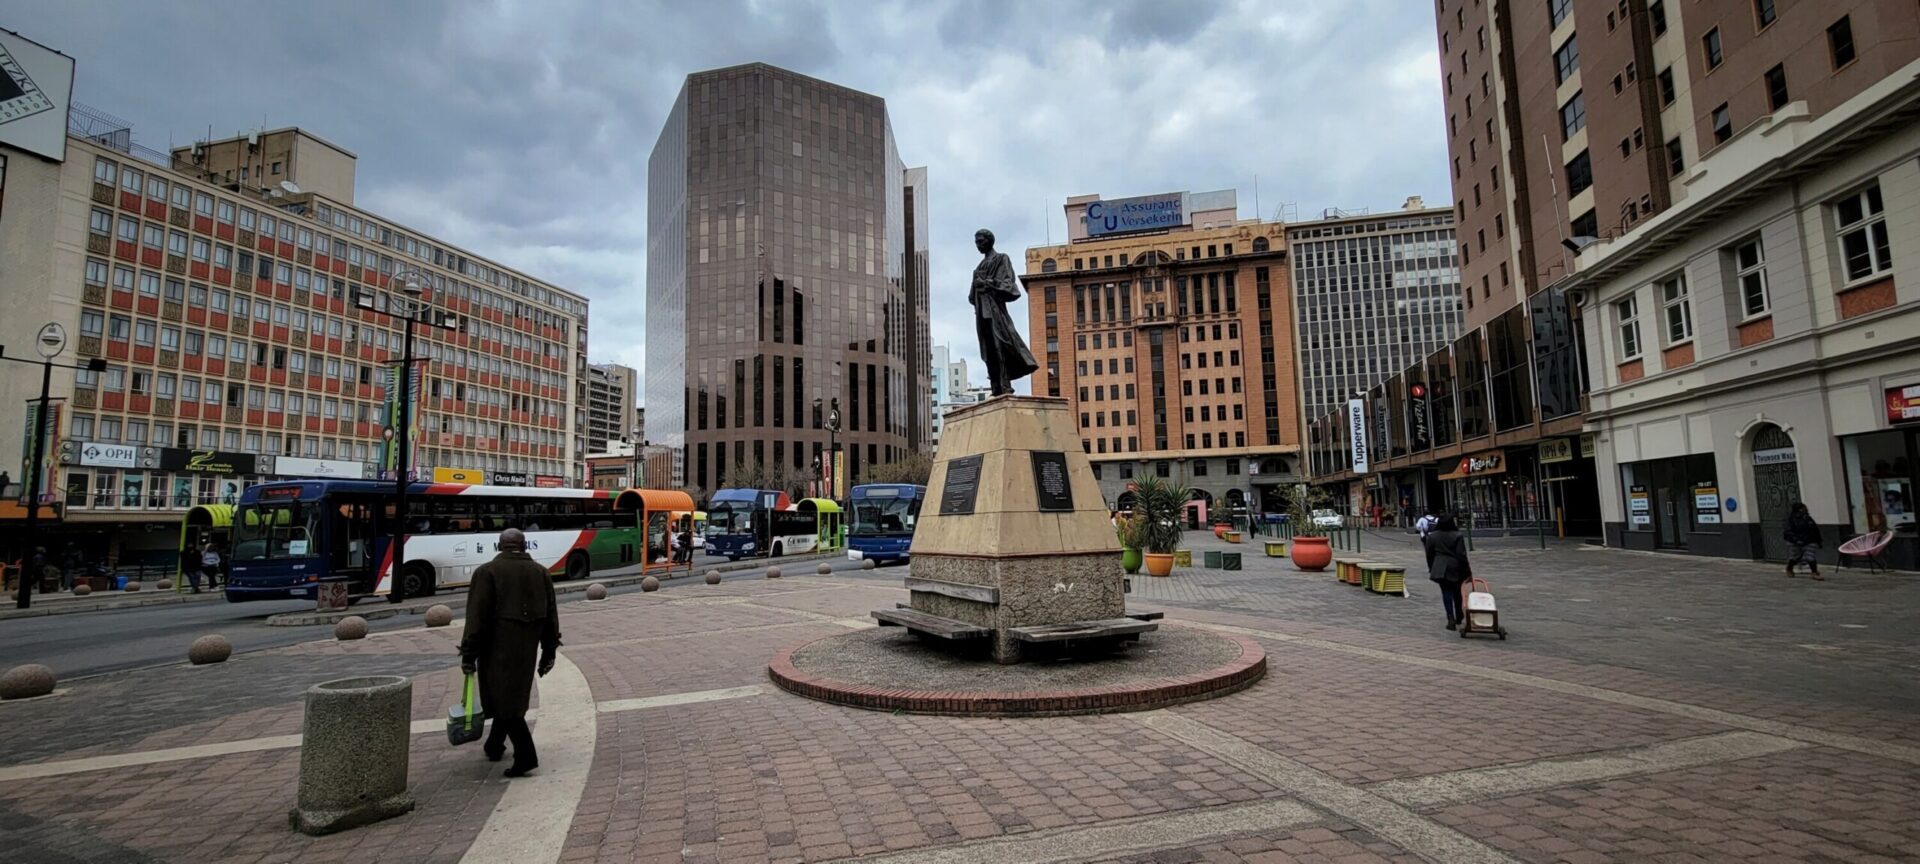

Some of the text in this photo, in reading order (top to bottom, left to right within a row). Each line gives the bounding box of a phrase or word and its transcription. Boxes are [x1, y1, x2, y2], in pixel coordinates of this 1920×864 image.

[1413, 398, 1427, 443] Pizza Hut
[1352, 406, 1364, 466] Tupperware
[105, 448, 132, 460] OPH
[1470, 455, 1499, 472] Pizza Hut
[494, 474, 526, 483] Chris Nails
